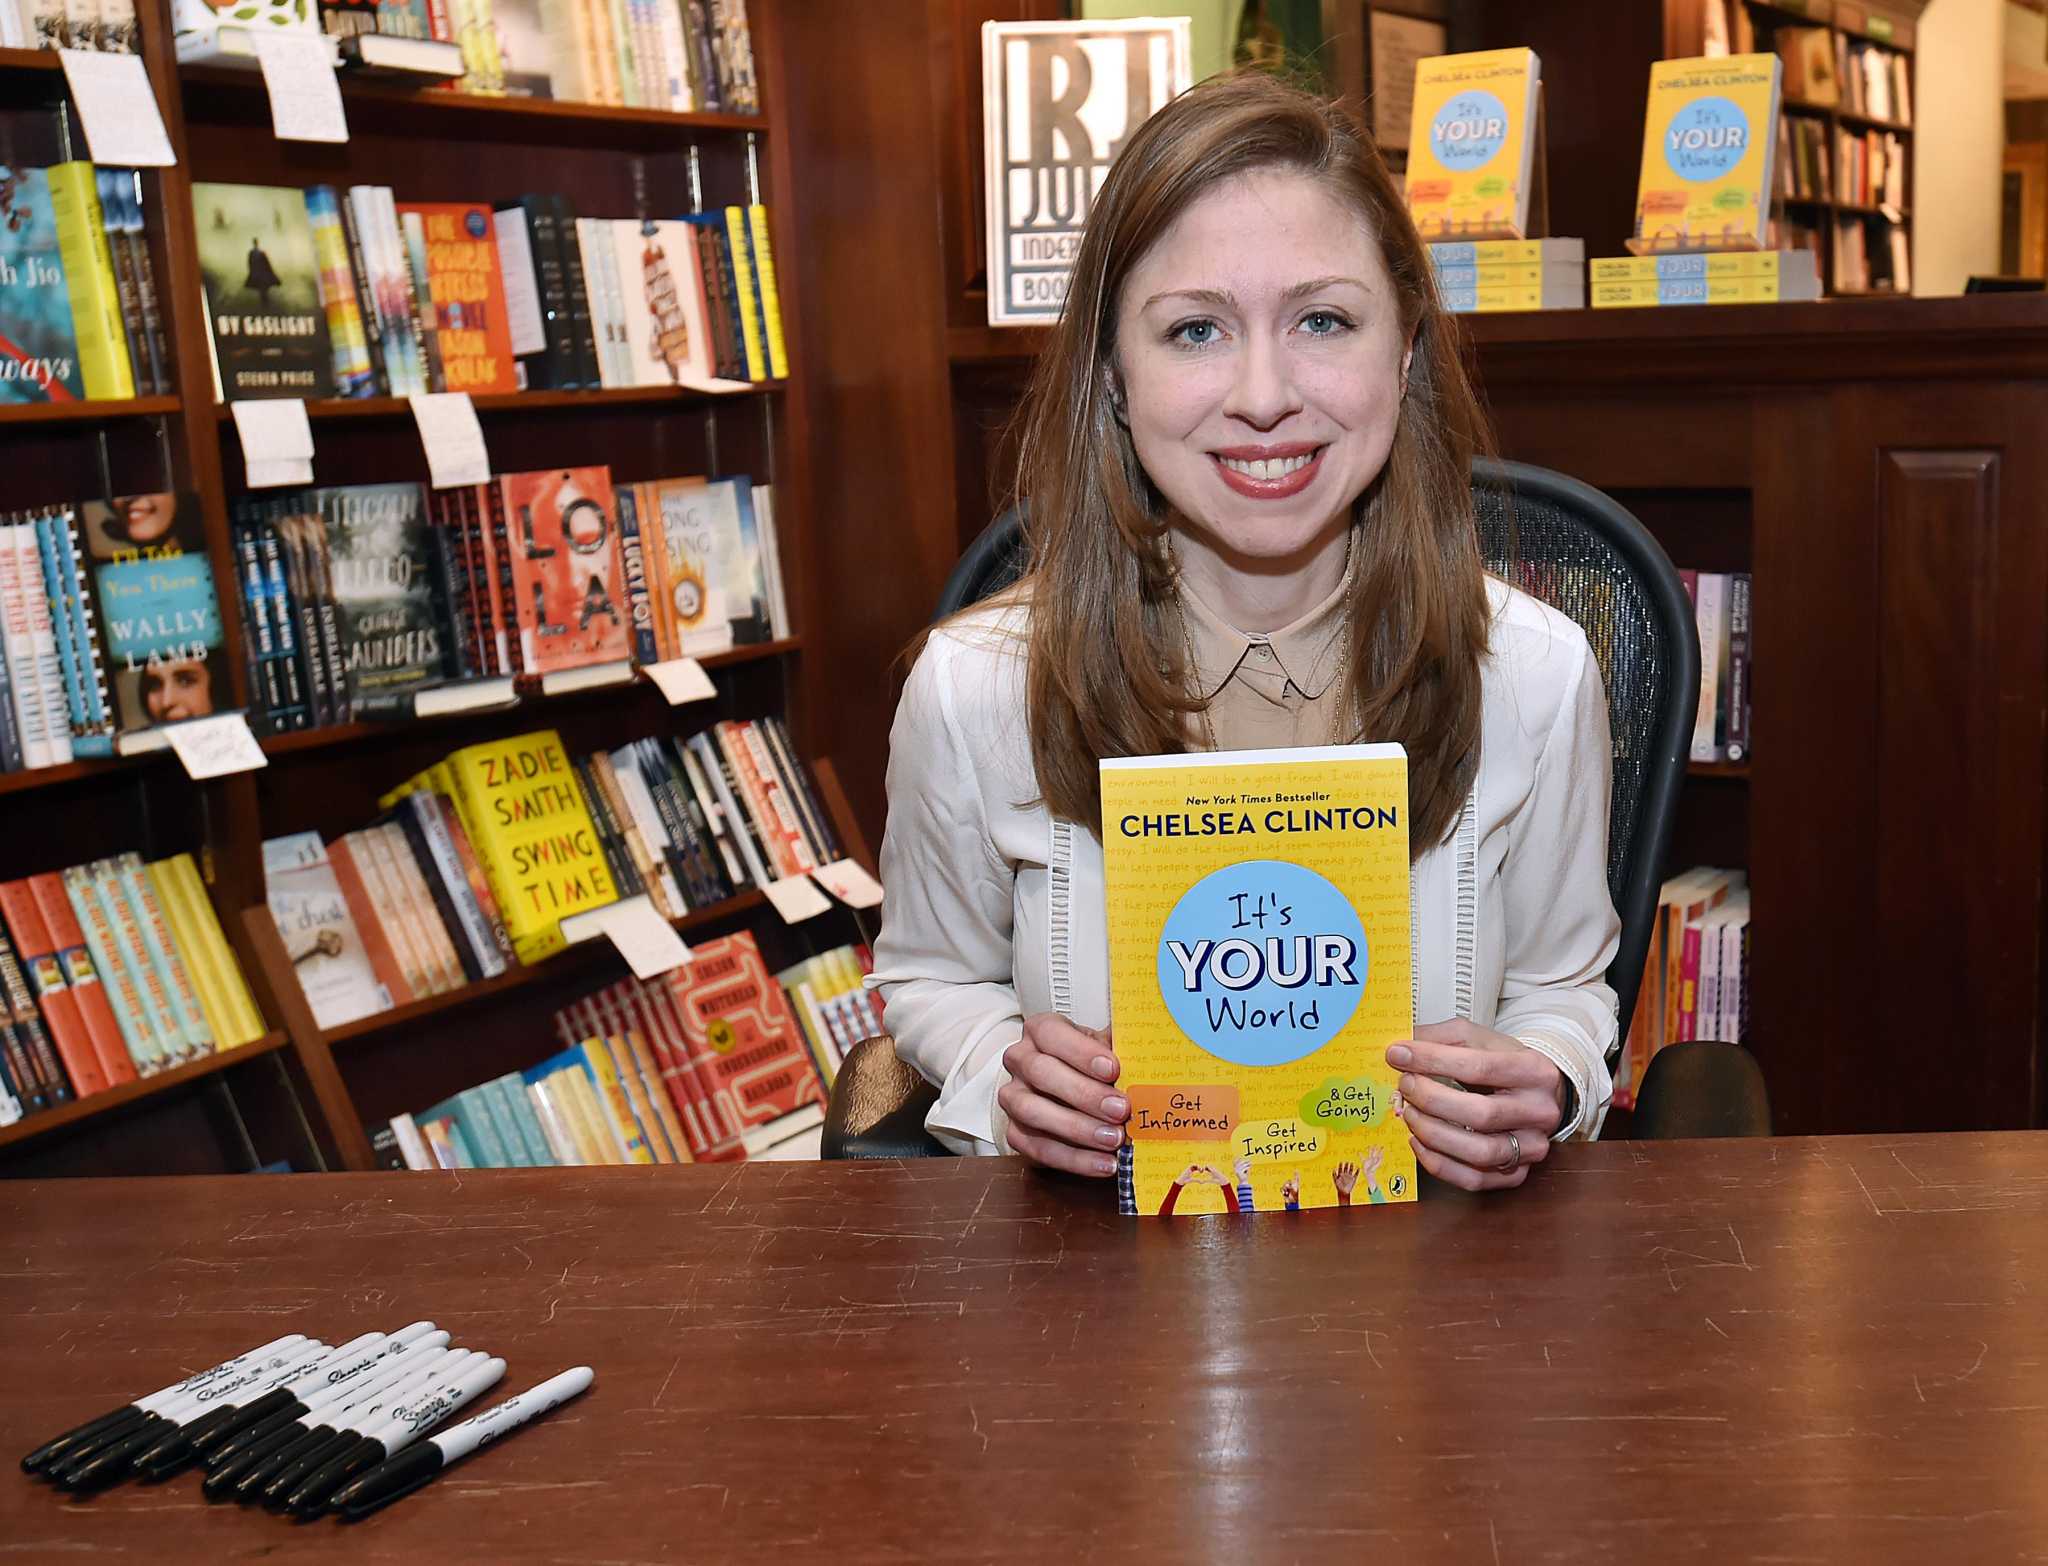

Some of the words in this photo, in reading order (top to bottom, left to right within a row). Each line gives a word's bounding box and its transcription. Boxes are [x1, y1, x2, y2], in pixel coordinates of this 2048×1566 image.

[1434, 118, 1504, 142] YOUR
[1671, 126, 1744, 150] YOUR
[243, 315, 316, 336] GASLIGHT
[519, 498, 609, 560] LO
[145, 543, 184, 561] Take
[533, 575, 620, 636] LA
[111, 607, 208, 641] WALLY
[125, 639, 208, 673] LAMB
[479, 745, 563, 788] ZADIE
[494, 783, 577, 827] SMITH
[1186, 796, 1210, 806] New
[1213, 795, 1237, 805] York
[1240, 794, 1272, 804] Times
[1275, 792, 1331, 803] Bestseller
[1119, 811, 1256, 838] CHELSEA
[1264, 806, 1397, 833] CLINTON
[511, 829, 594, 875] SWING
[523, 866, 609, 914] TIME
[1228, 891, 1293, 930] It's
[1166, 934, 1360, 993] YOUR
[1205, 997, 1320, 1032] World
[1170, 1093, 1203, 1111] Get
[1316, 1096, 1375, 1123] Going!
[1330, 1088, 1341, 1100] &
[1343, 1086, 1372, 1101] Get
[1137, 1110, 1229, 1131] Informed
[1266, 1122, 1297, 1138] Get
[1242, 1136, 1317, 1160] Inspired
